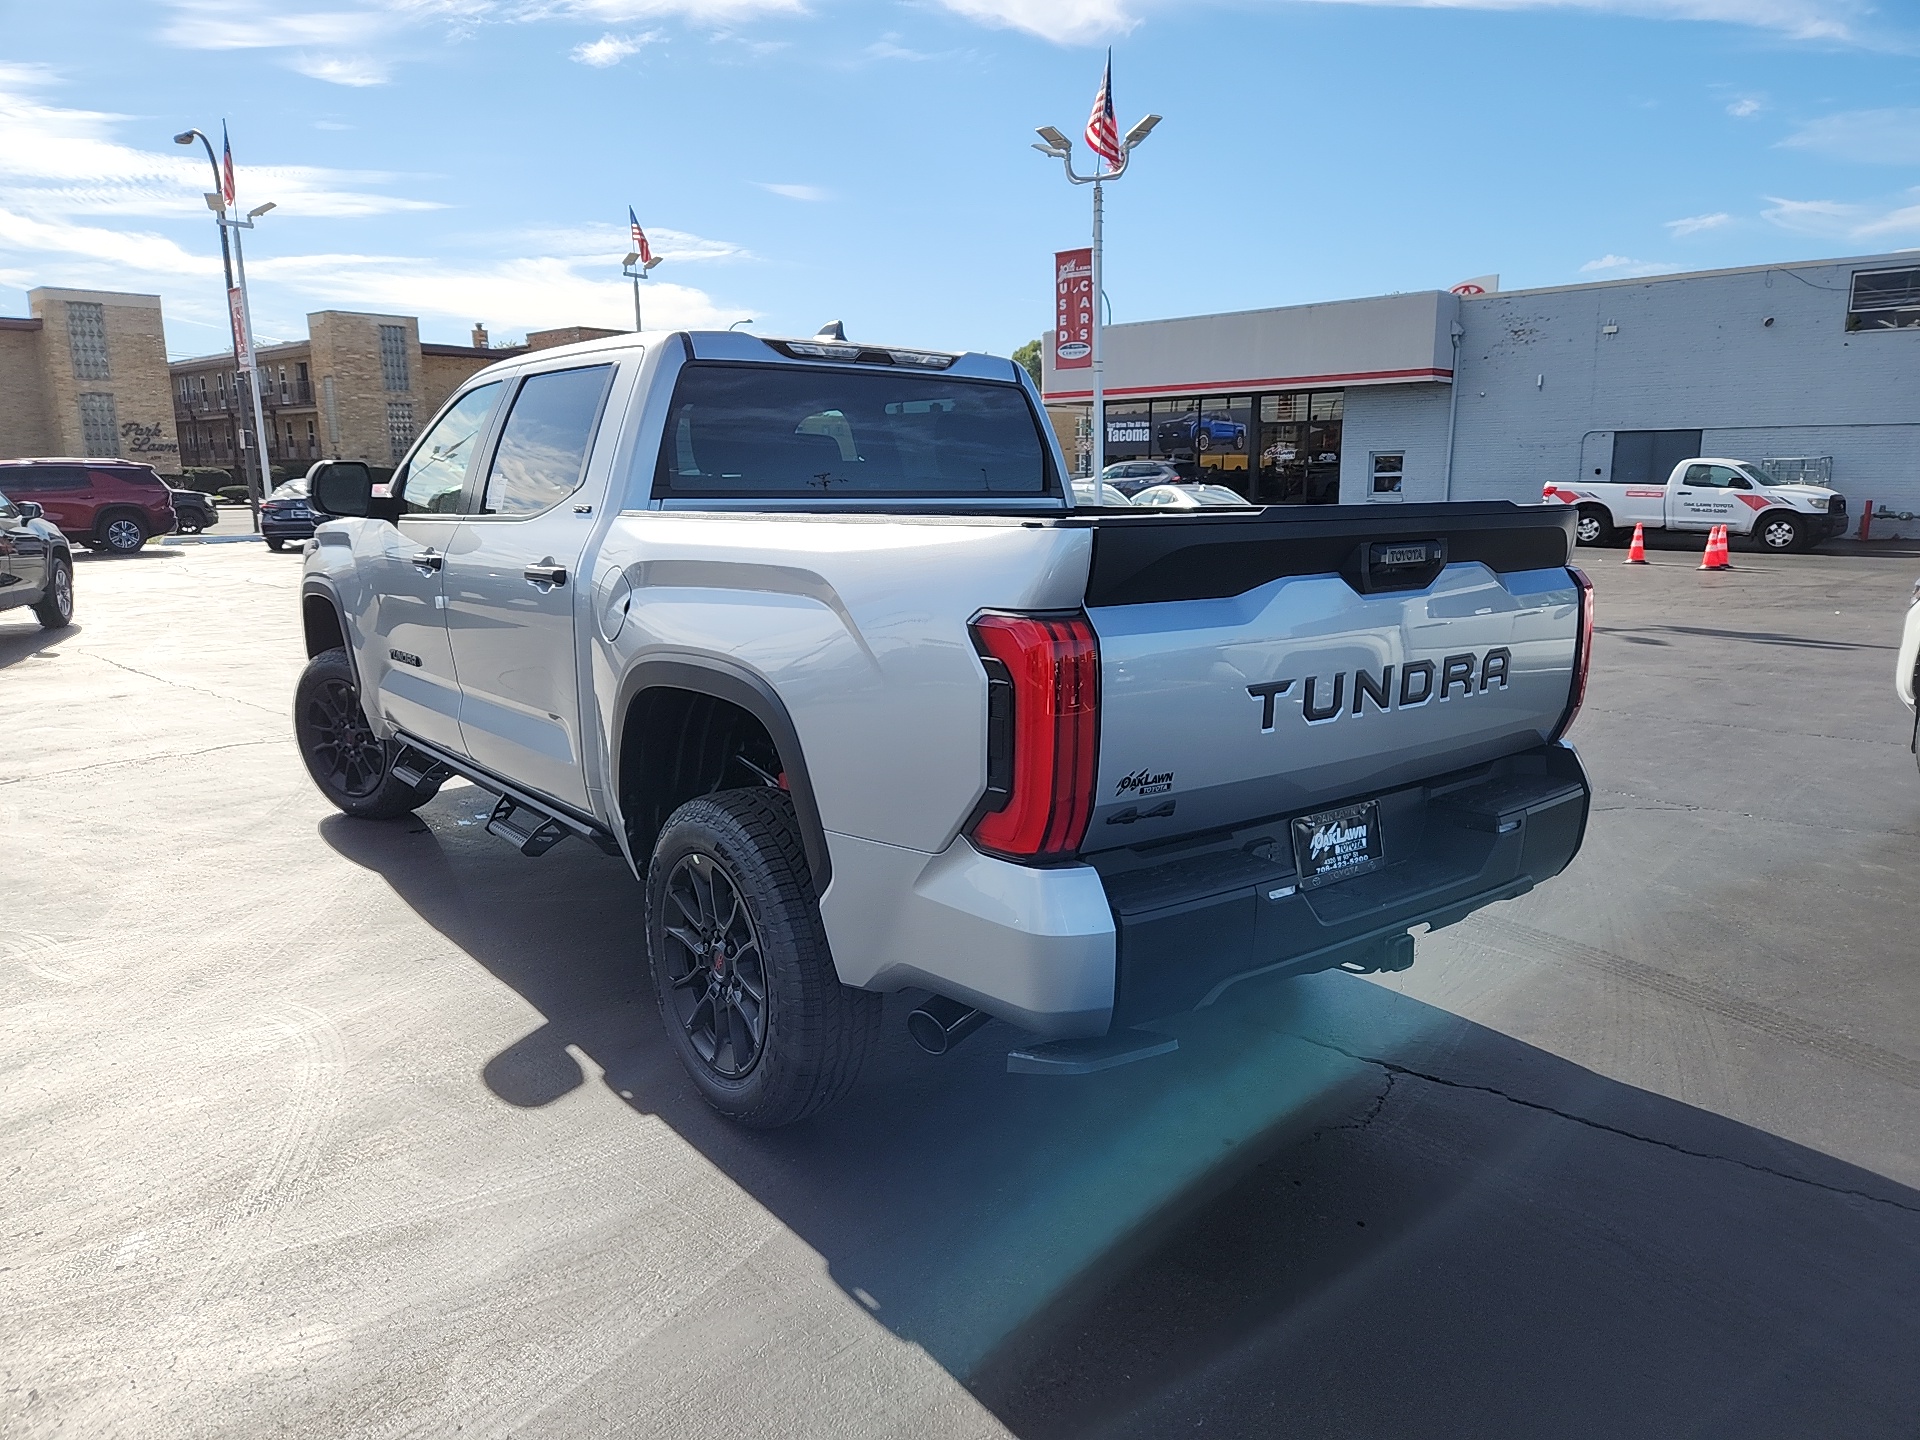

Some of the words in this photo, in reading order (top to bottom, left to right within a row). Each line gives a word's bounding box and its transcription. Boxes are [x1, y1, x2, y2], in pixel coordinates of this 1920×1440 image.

[1059, 282, 1069, 342] USED
[1080, 280, 1090, 340] CARS
[121, 421, 162, 437] Park
[1106, 428, 1150, 442] Tacoma
[130, 437, 178, 453] Lawn
[1390, 548, 1423, 562] TOYOTA
[1245, 646, 1512, 734] TUNDRA
[1143, 784, 1168, 795] TOYOTA
[1337, 838, 1365, 854] TOYOTA
[1315, 854, 1369, 874] 708-423-5200
[1328, 865, 1360, 880] TOYOTA
